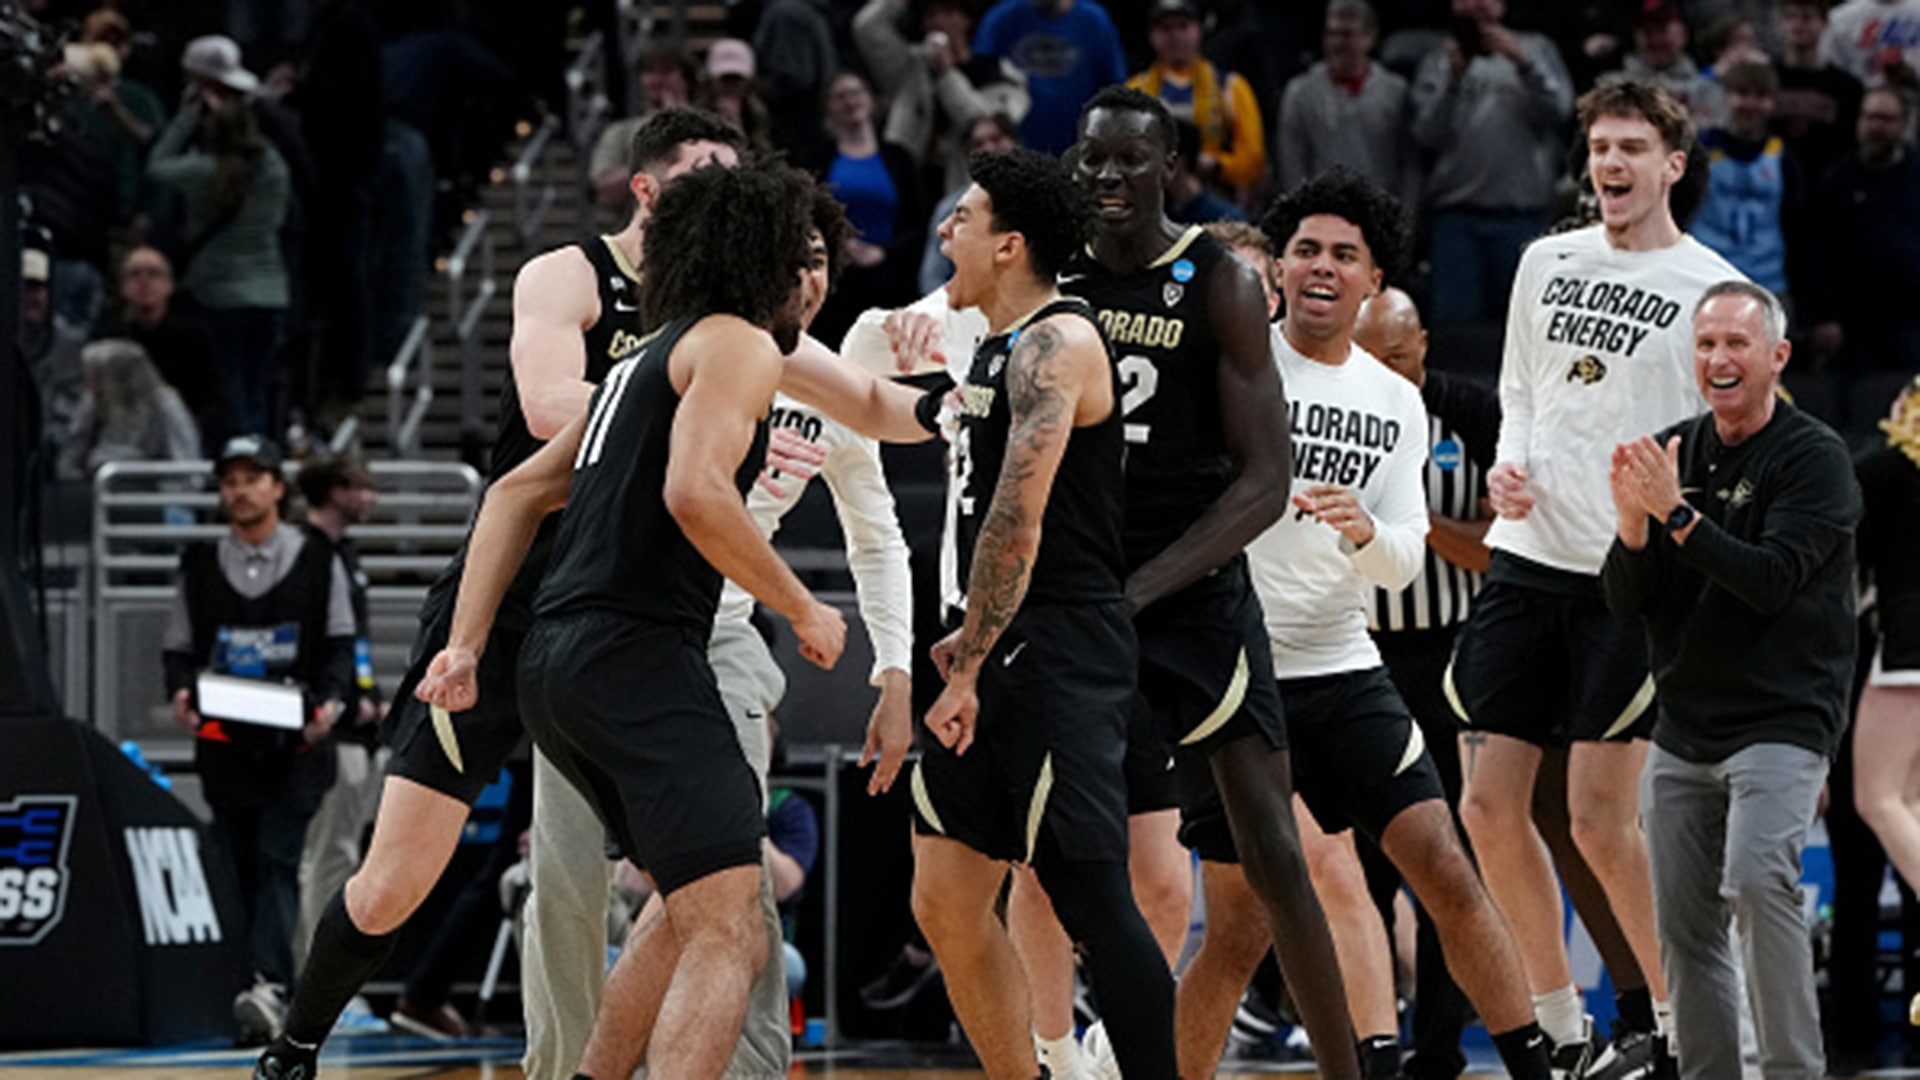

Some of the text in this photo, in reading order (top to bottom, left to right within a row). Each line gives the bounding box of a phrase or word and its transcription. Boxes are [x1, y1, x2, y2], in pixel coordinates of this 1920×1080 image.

[1541, 277, 1681, 330] COLORADO
[1546, 311, 1649, 358] ENERGY
[1286, 400, 1401, 453] LORADO
[124, 826, 222, 945] NCAA
